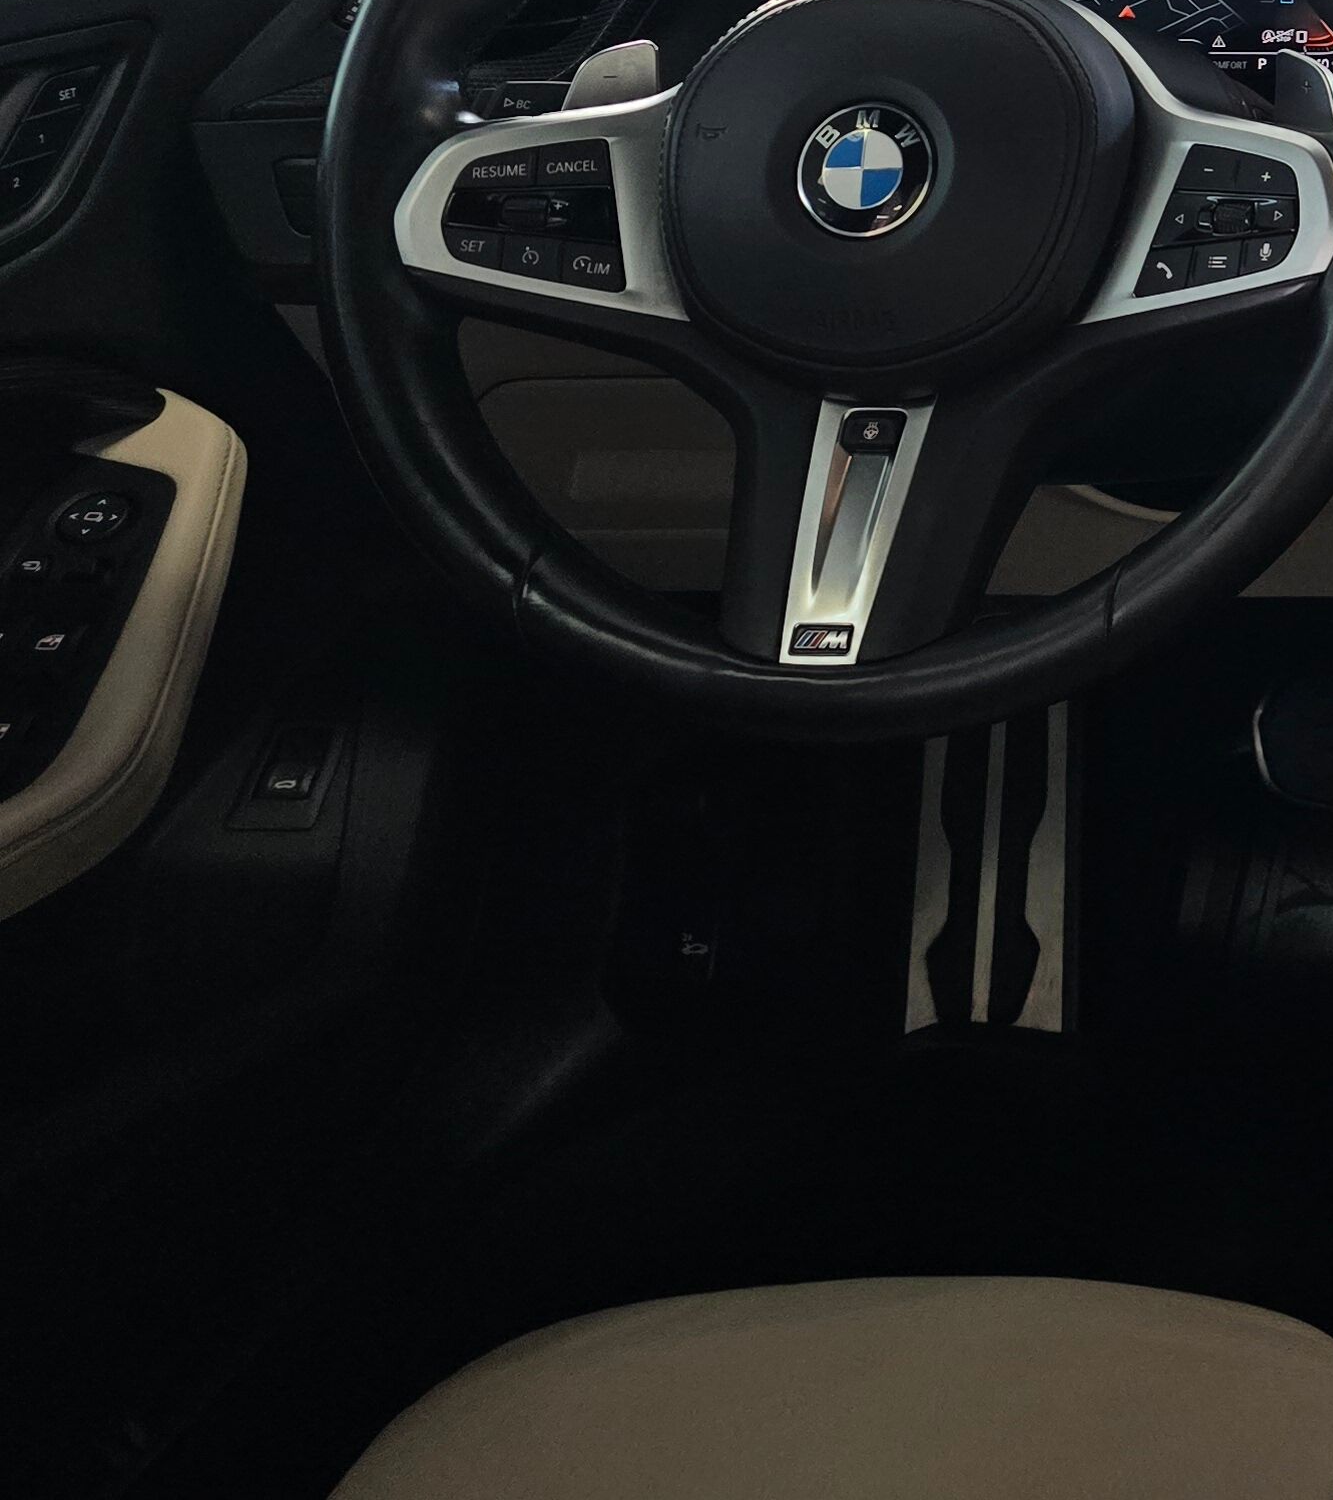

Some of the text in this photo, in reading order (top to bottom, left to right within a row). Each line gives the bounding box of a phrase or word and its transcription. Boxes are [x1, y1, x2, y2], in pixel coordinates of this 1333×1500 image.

[1257, 57, 1268, 70] P
[58, 87, 77, 101] SET
[515, 99, 532, 110] BC
[815, 109, 921, 149] BMW
[472, 163, 527, 179] RESUME
[546, 159, 598, 175] CANCEL
[459, 239, 486, 253] SET
[586, 262, 611, 276] LIM
